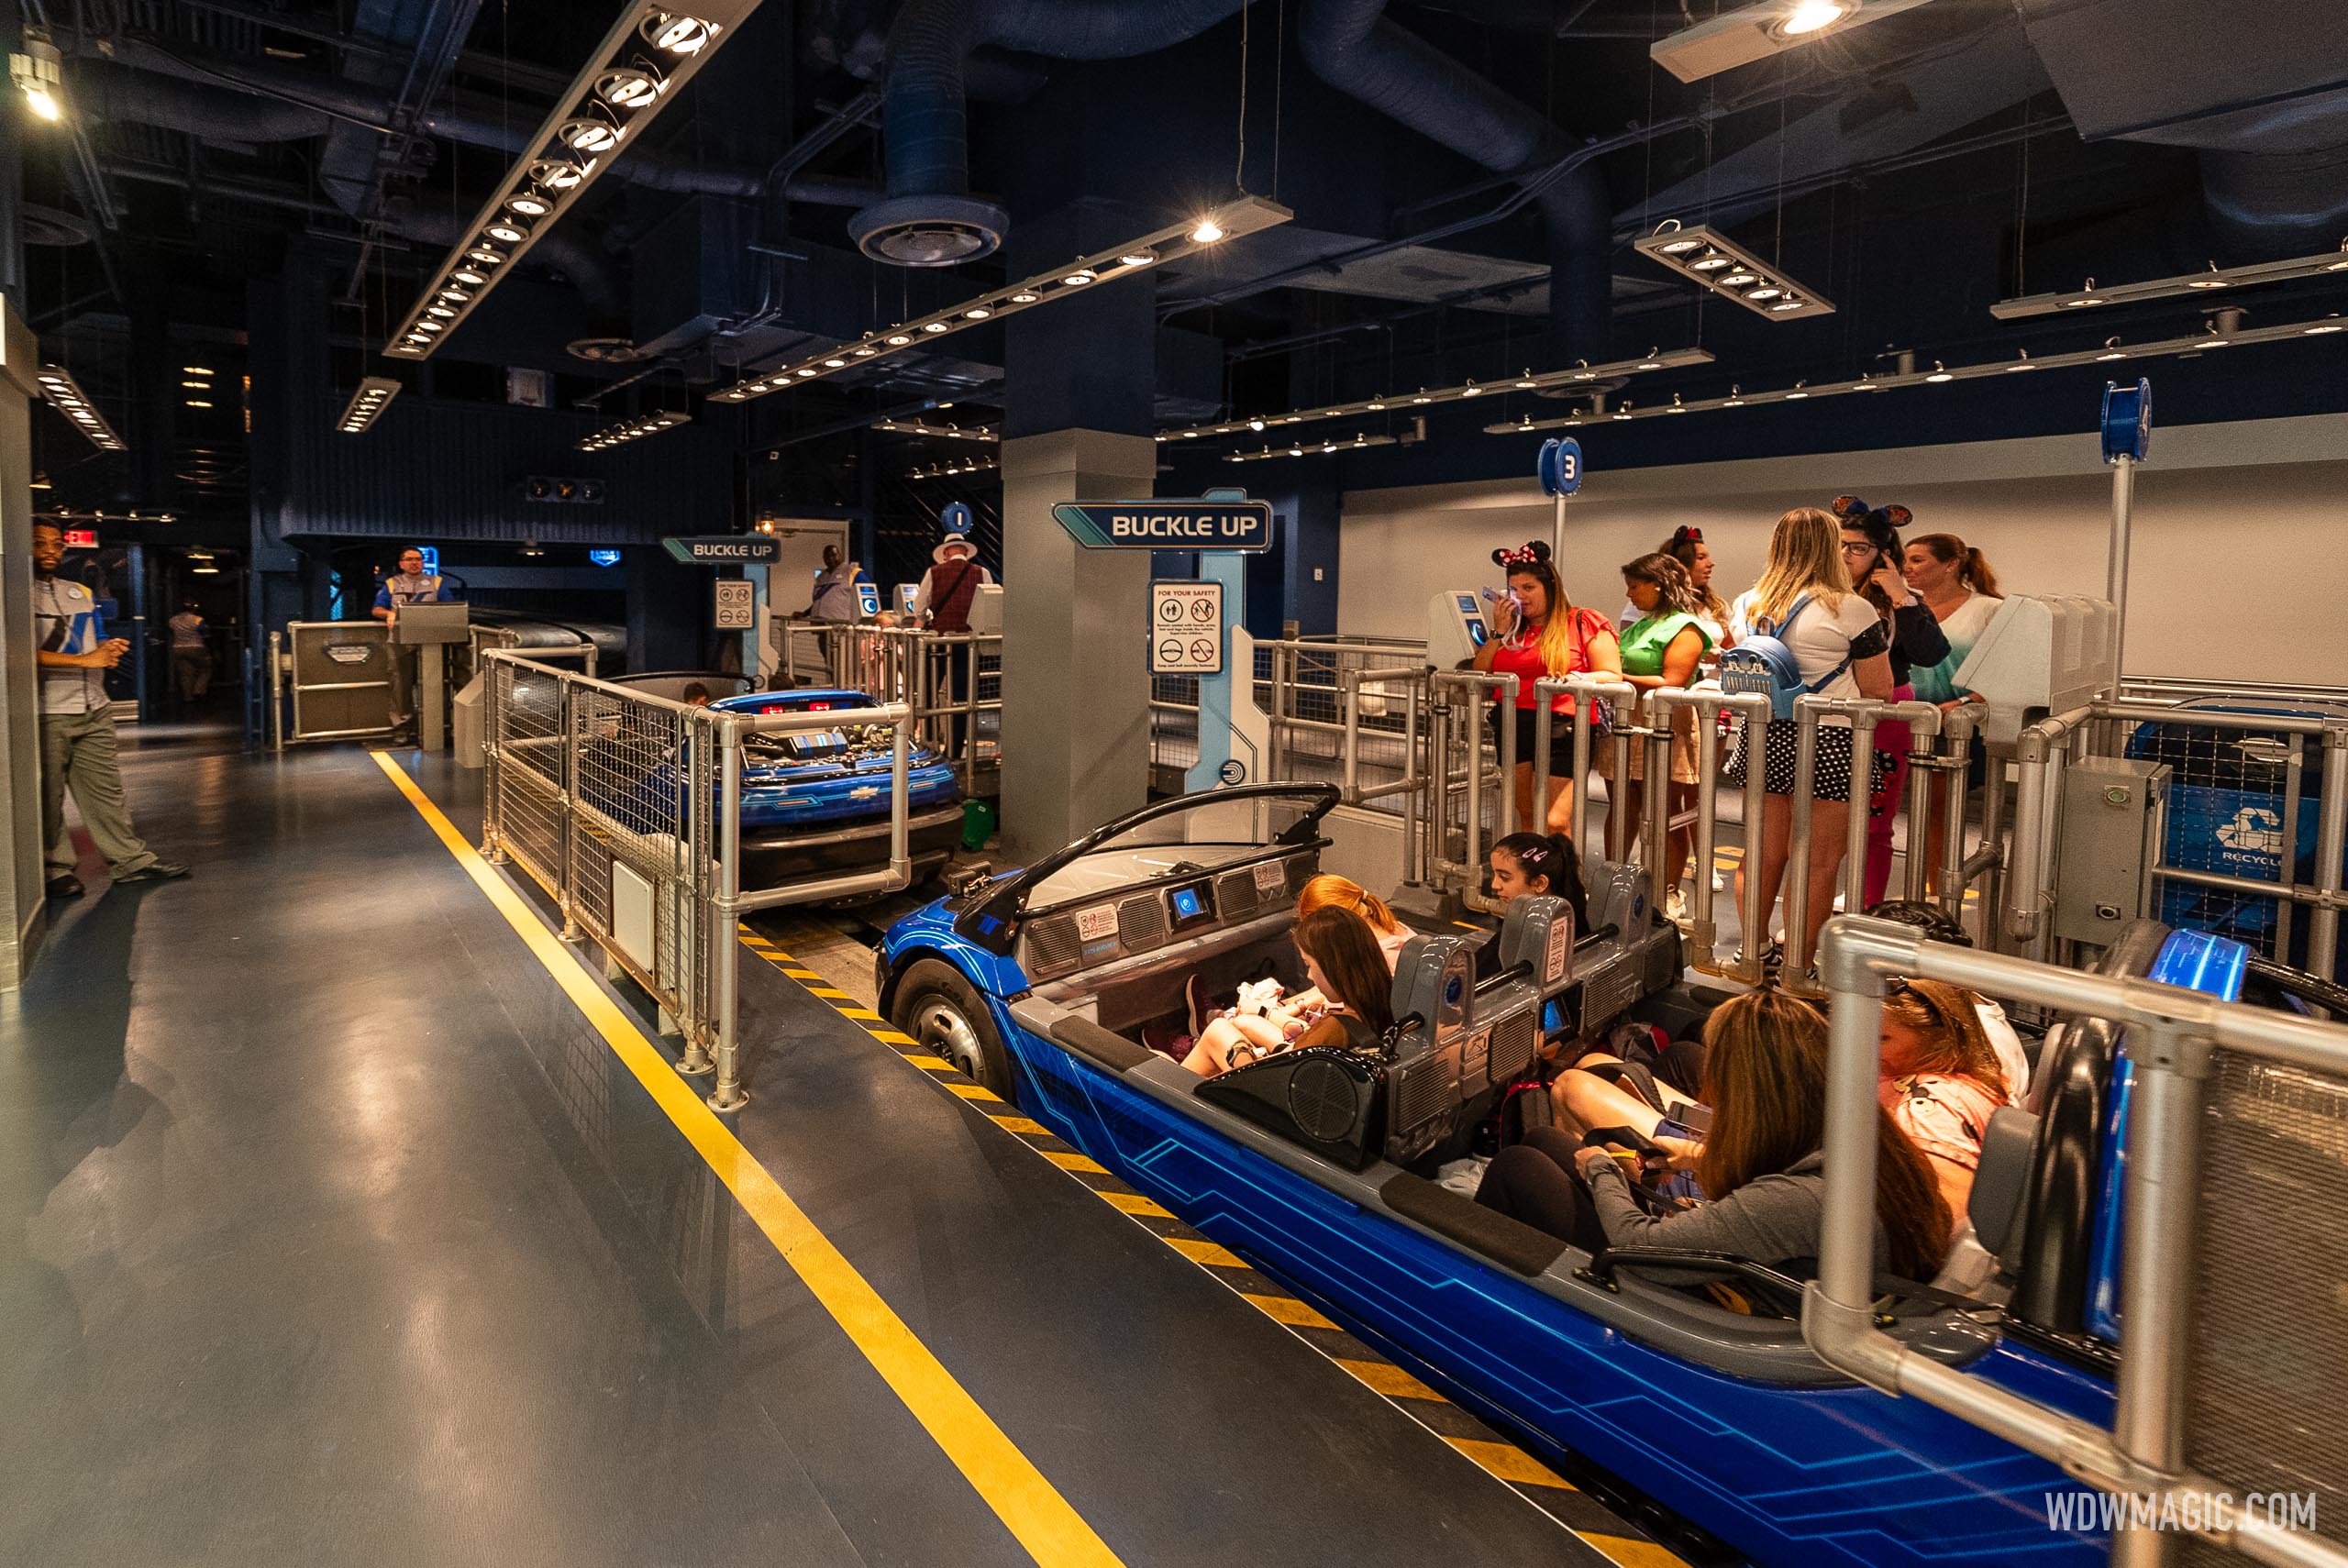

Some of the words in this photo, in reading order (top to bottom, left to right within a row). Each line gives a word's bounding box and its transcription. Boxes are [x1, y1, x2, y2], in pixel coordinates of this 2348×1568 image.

[1565, 455, 1575, 479] 3
[1113, 516, 1213, 536] BUCKLE
[1222, 516, 1257, 536] UP
[693, 545, 748, 556] BUCKLE
[752, 546, 772, 556] UP
